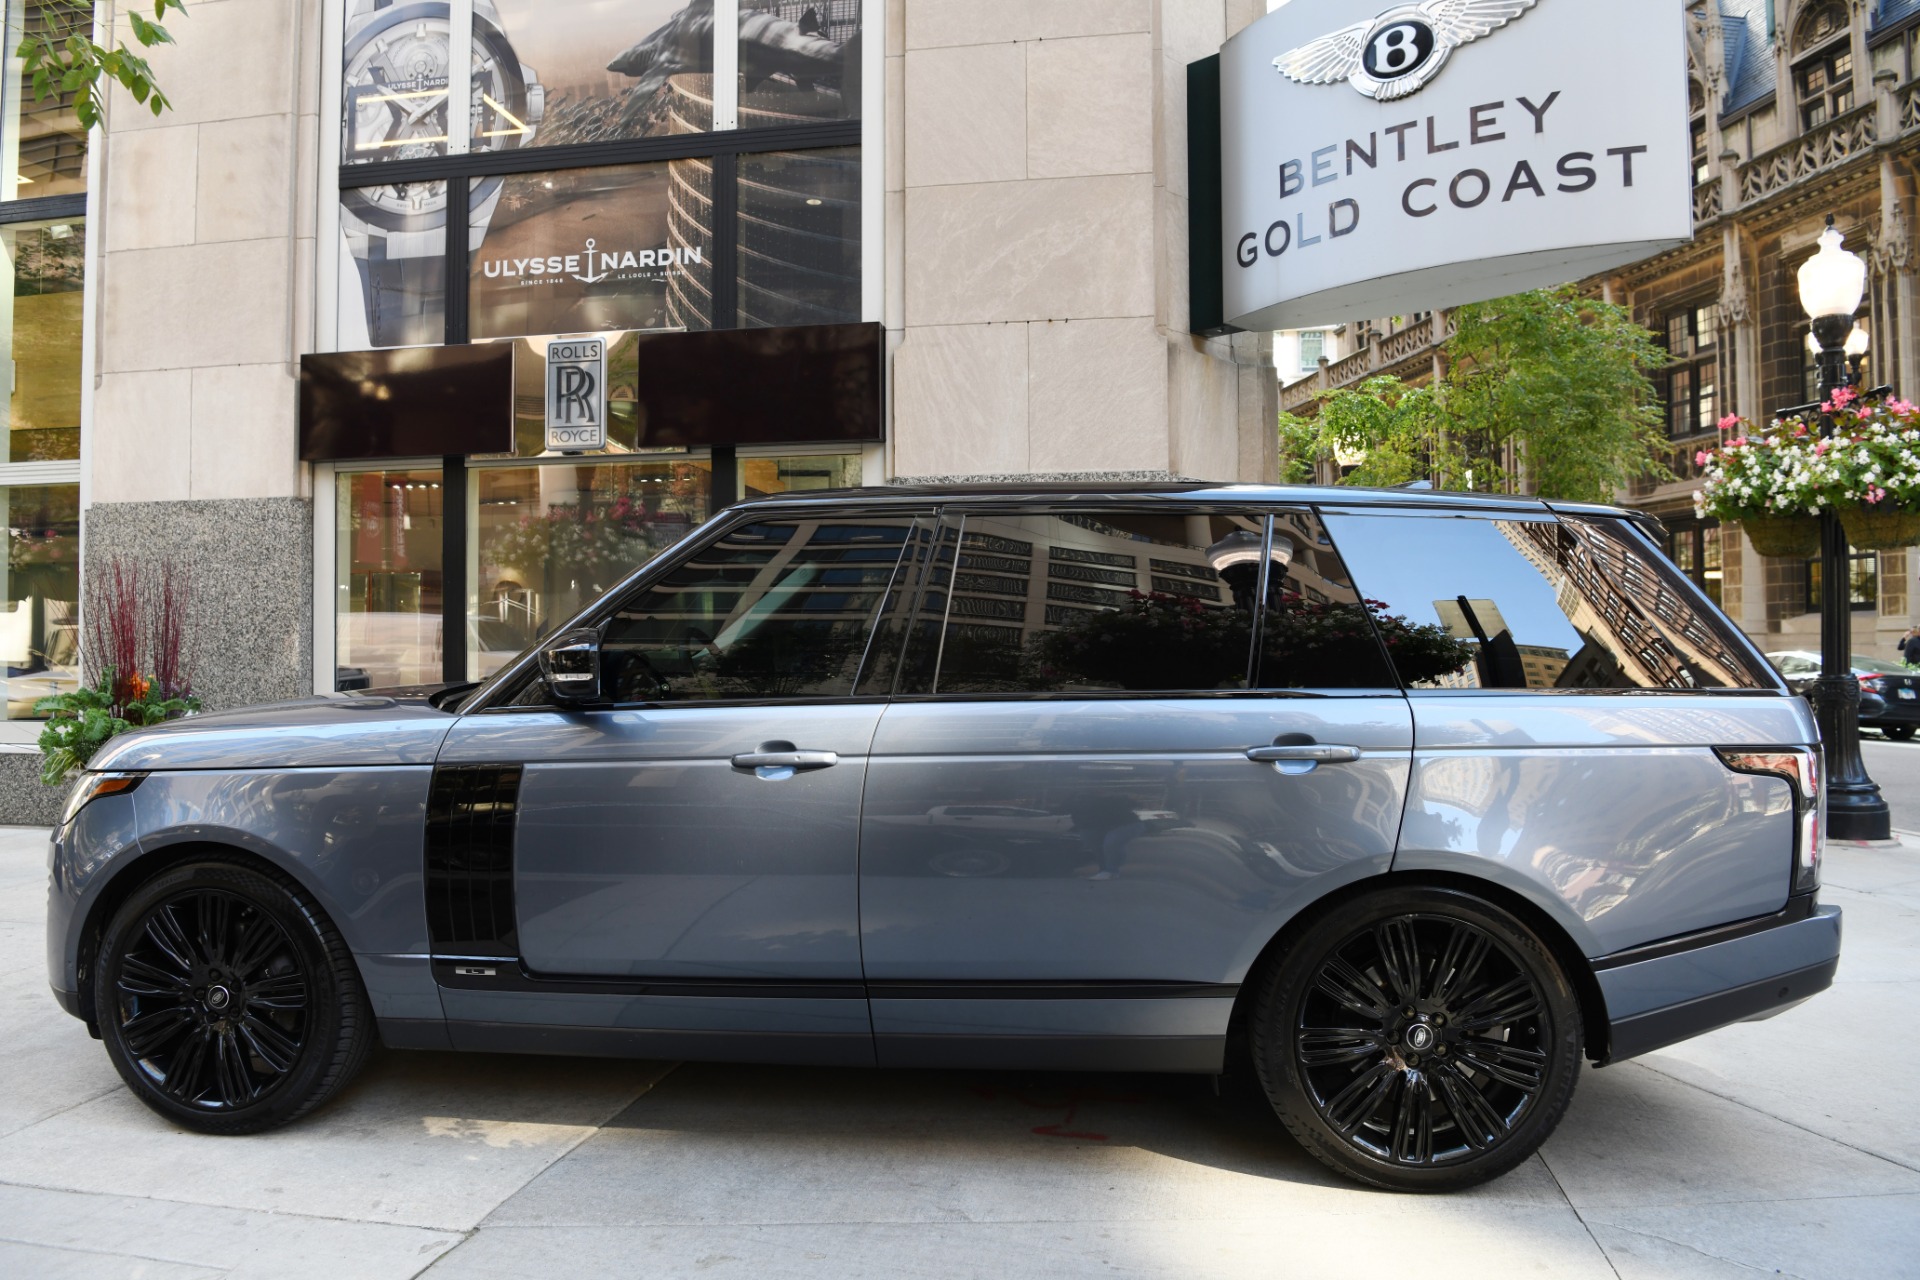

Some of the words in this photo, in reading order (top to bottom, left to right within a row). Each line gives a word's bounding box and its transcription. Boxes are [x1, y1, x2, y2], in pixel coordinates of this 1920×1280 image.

[388, 81, 417, 89] ULYSSE
[1279, 90, 1562, 199] BENTLEY
[1236, 197, 1360, 269] GOLD
[1401, 145, 1648, 218] COAST
[484, 254, 580, 278] ULYSSE
[600, 246, 702, 270] NARDIN
[552, 345, 598, 359] ROLLS
[555, 365, 595, 424] RR
[551, 430, 598, 443] ROYCE
